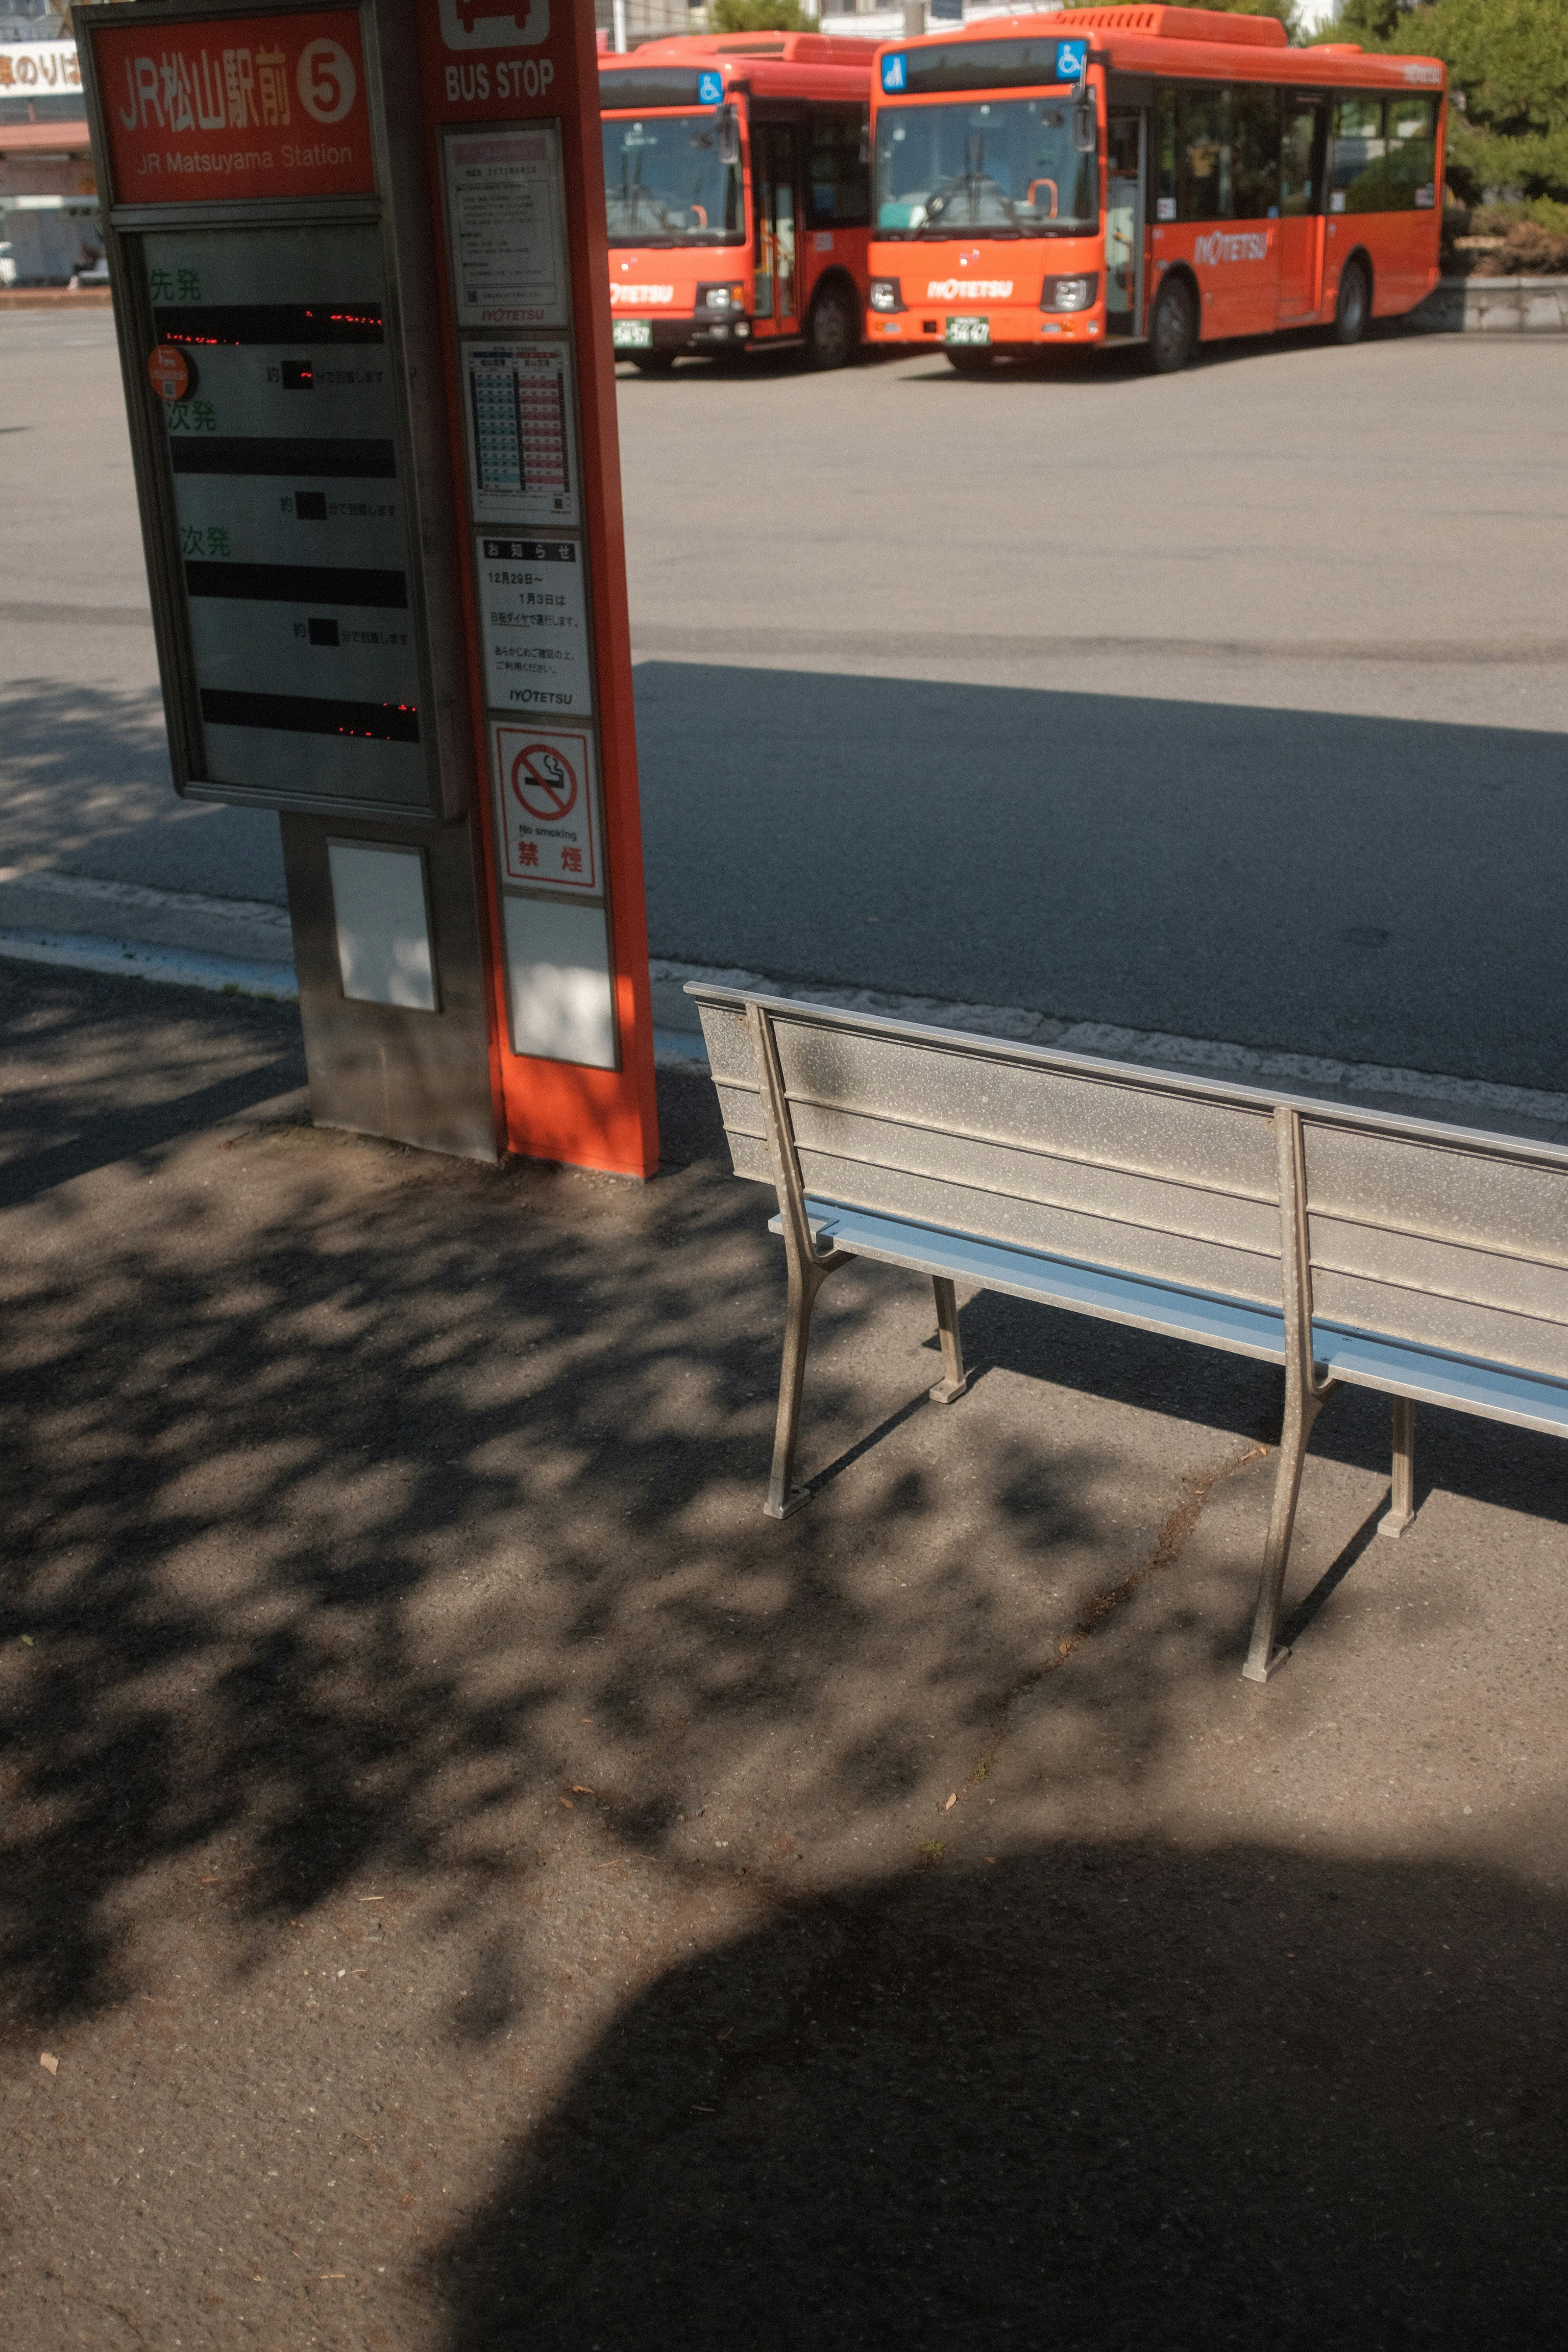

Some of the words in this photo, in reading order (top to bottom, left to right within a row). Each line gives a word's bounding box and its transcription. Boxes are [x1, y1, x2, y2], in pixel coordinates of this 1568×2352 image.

[119, 43, 290, 132] JR松山駅前
[445, 62, 491, 102] BUS
[496, 59, 555, 100] STOP
[137, 153, 161, 174] JR
[166, 152, 273, 174] Matsuyama
[281, 143, 353, 167] Station
[150, 268, 202, 301] 先発
[481, 307, 545, 323] IYOTETSU
[165, 400, 216, 431] 次発
[181, 526, 231, 557] 次発
[488, 543, 571, 559] お知らせ
[519, 593, 566, 605] 1月3日は
[510, 690, 572, 705] IYOTETSU
[519, 824, 532, 834] No
[535, 827, 577, 842] smoking
[518, 841, 582, 873] 禁煙
